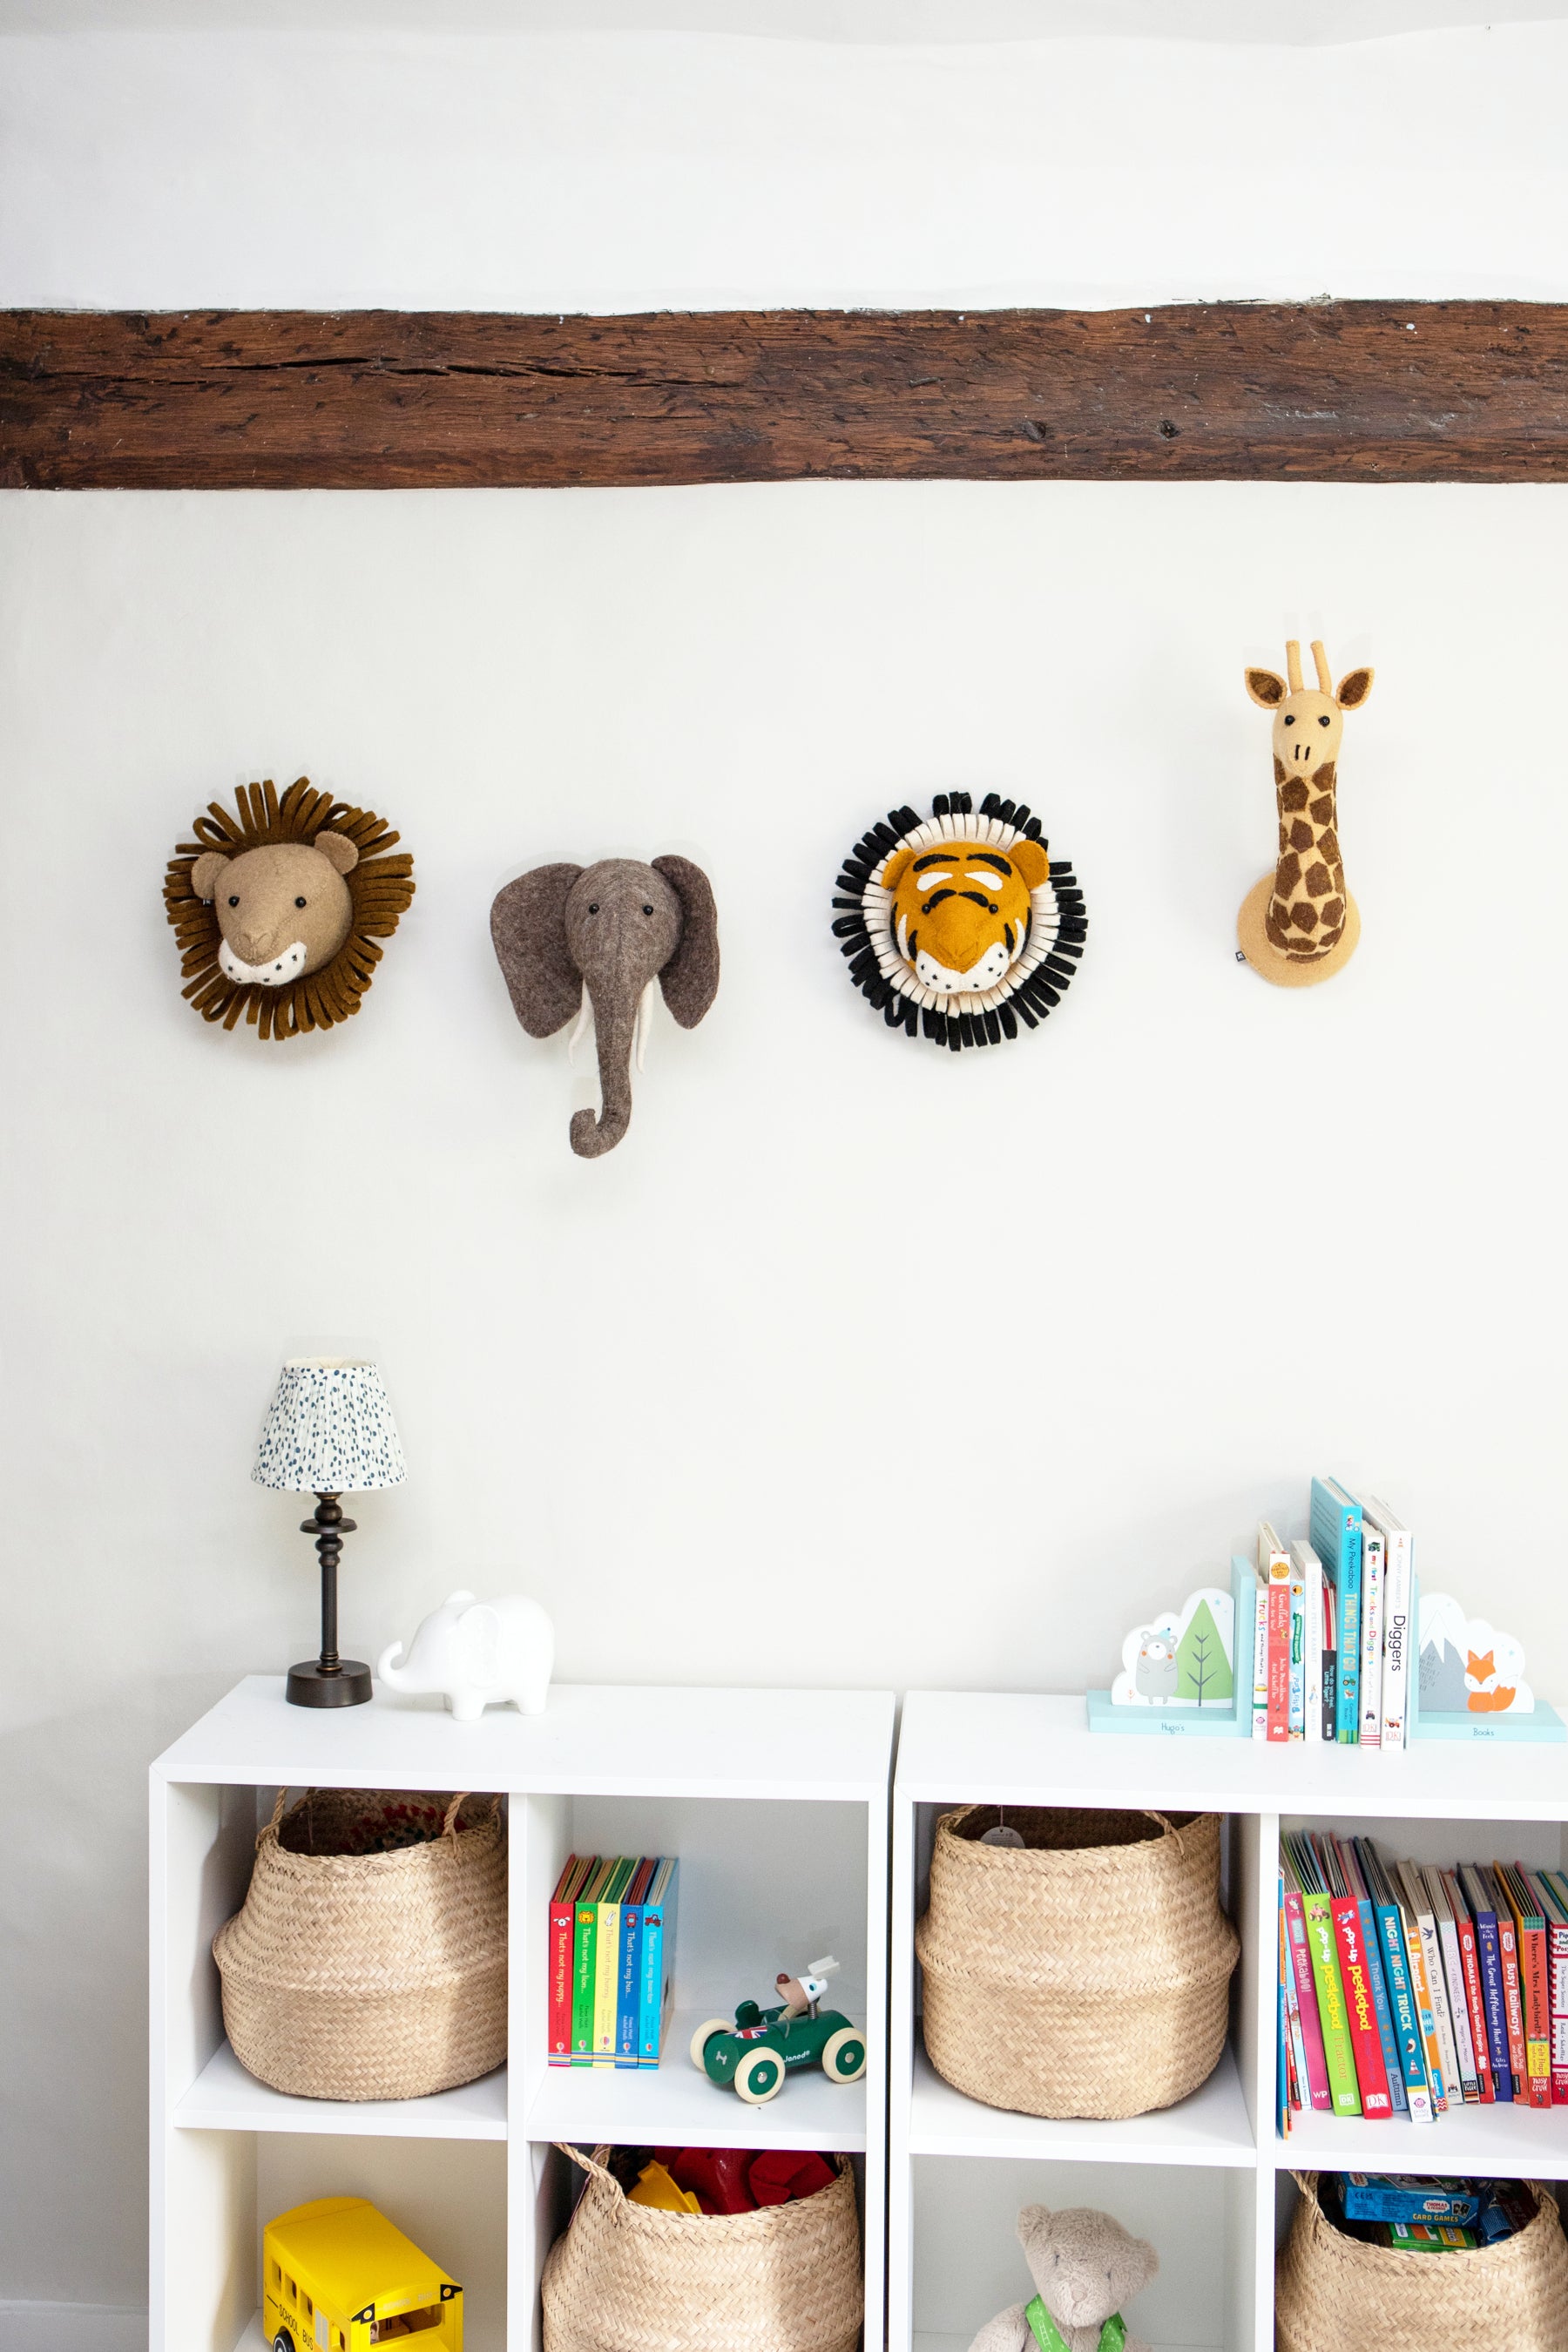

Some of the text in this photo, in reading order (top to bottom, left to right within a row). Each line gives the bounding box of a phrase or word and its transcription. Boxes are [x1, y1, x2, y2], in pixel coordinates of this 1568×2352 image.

[1347, 1538, 1355, 1549] My
[1370, 1556, 1376, 1565] my
[1277, 1594, 1288, 1628] Gruffalo,
[1343, 1593, 1357, 1671] THINGS THAT GO
[1367, 1631, 1376, 1665] Diggers
[1389, 1615, 1406, 1671] Diggers
[1161, 1722, 1185, 1734] Hugo's
[1473, 1727, 1495, 1736] Books
[582, 1928, 591, 1948] That's
[648, 1932, 657, 1951] That's
[1342, 1927, 1357, 1963] pop-up
[1426, 1946, 1436, 1965] Who
[556, 1969, 564, 1979] my
[579, 1963, 587, 1974] my
[603, 1965, 610, 1976] my
[624, 1969, 631, 1979] my
[645, 1967, 653, 1978] my
[1294, 1948, 1311, 1992] Peekaboo!
[1384, 1916, 1413, 2031] NIGHT NIGHT TRUCK
[1429, 1969, 1438, 1984] Can
[1444, 1943, 1461, 2002] ABC KINDNESS
[1464, 1953, 1477, 1984] THOMAS
[1371, 1962, 1385, 2011] Thank You
[1315, 1926, 1348, 2079] pop-up peekaboo! Tractor
[1347, 1964, 1372, 2031] peekaboo!
[1434, 1996, 1444, 2017] Find?
[1470, 1996, 1479, 2014] Really
[1485, 1954, 1502, 2044] The Great Heffalump Hunt
[1505, 1963, 1520, 2036] Busy Railways
[1531, 1990, 1541, 2033] Ladybird?
[1340, 2095, 1354, 2104] DK
[1391, 2073, 1402, 2106] Autumn
[1367, 2096, 1387, 2106] DK
[1434, 2214, 1458, 2223] GAMES
[279, 2303, 314, 2350] SCHOOL BUS
